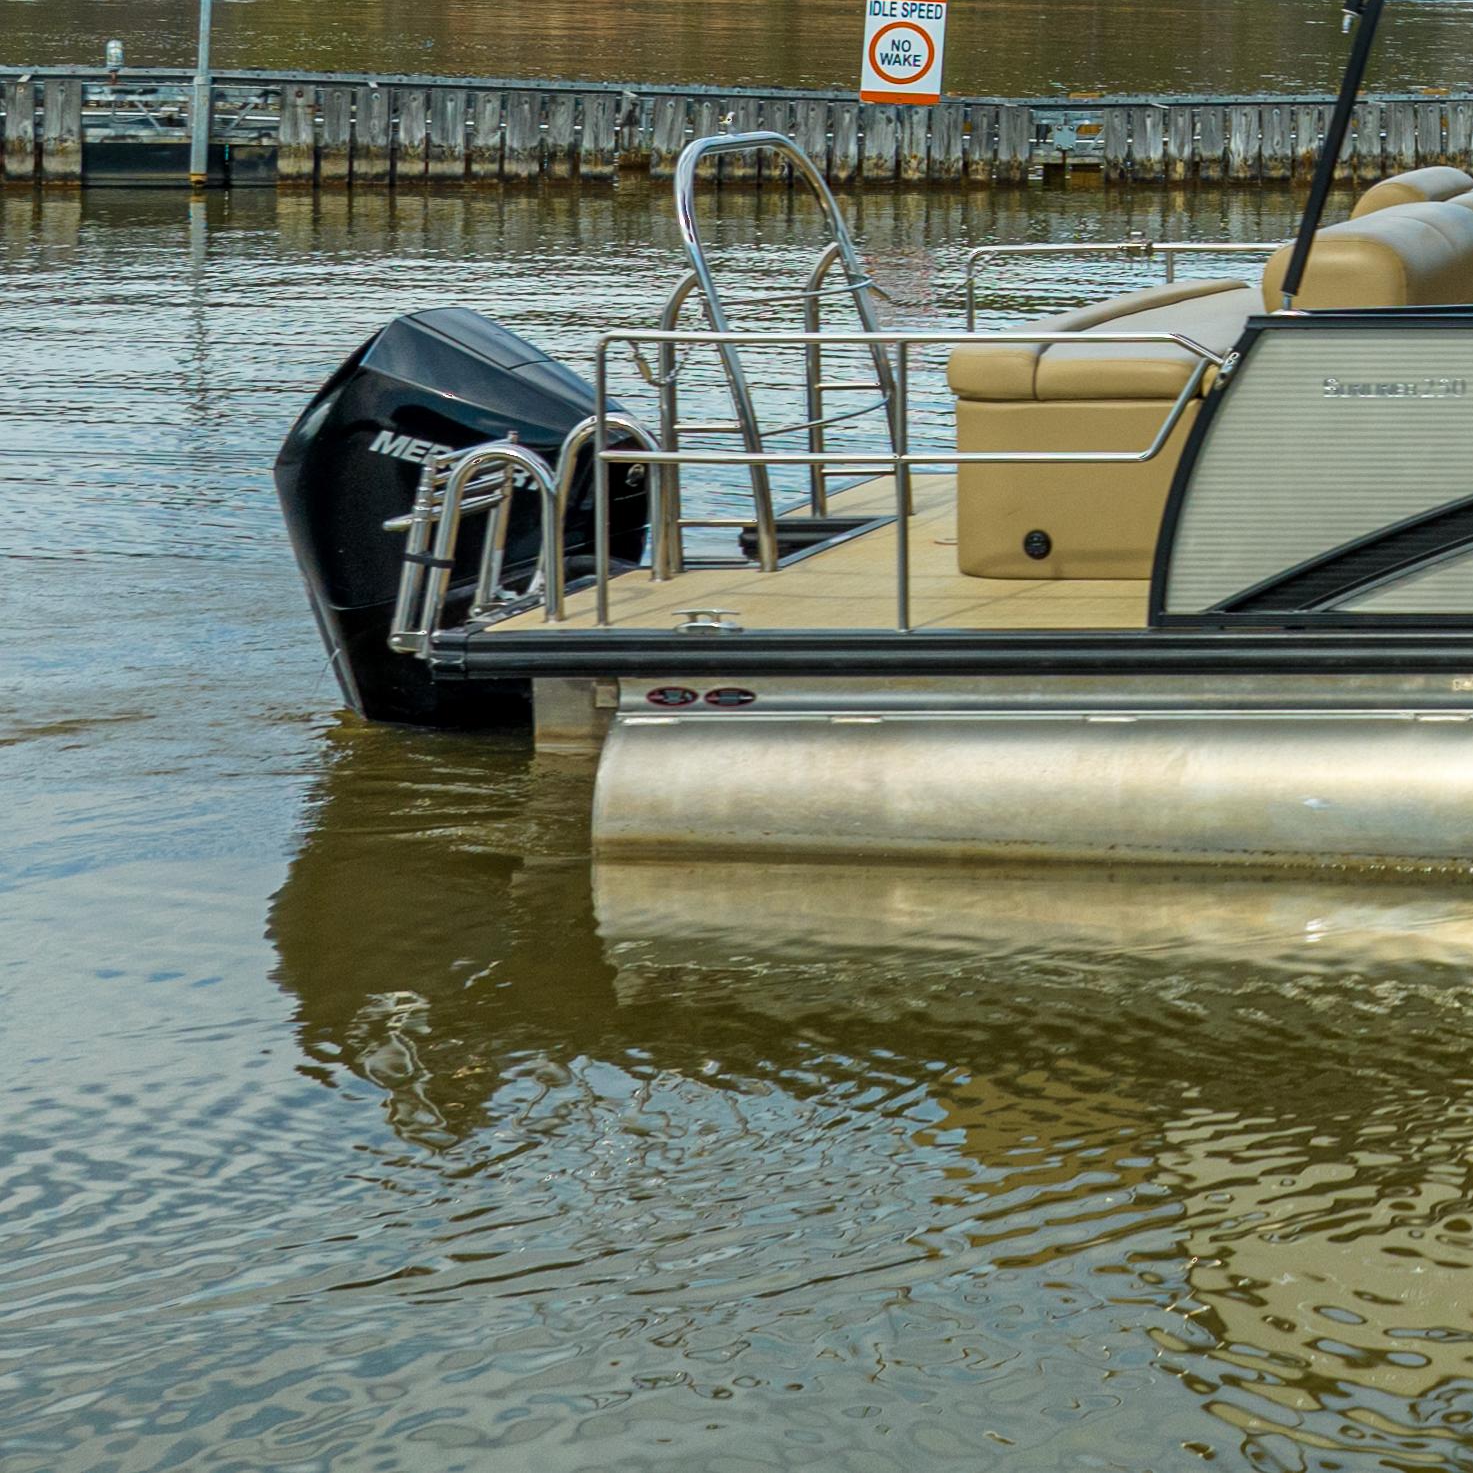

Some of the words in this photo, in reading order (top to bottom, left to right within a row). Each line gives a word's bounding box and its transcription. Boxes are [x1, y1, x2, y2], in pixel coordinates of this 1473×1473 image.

[869, 0, 898, 18] IDLE
[900, 2, 943, 20] SPEED
[891, 39, 912, 53] NO
[880, 52, 922, 67] WAKE
